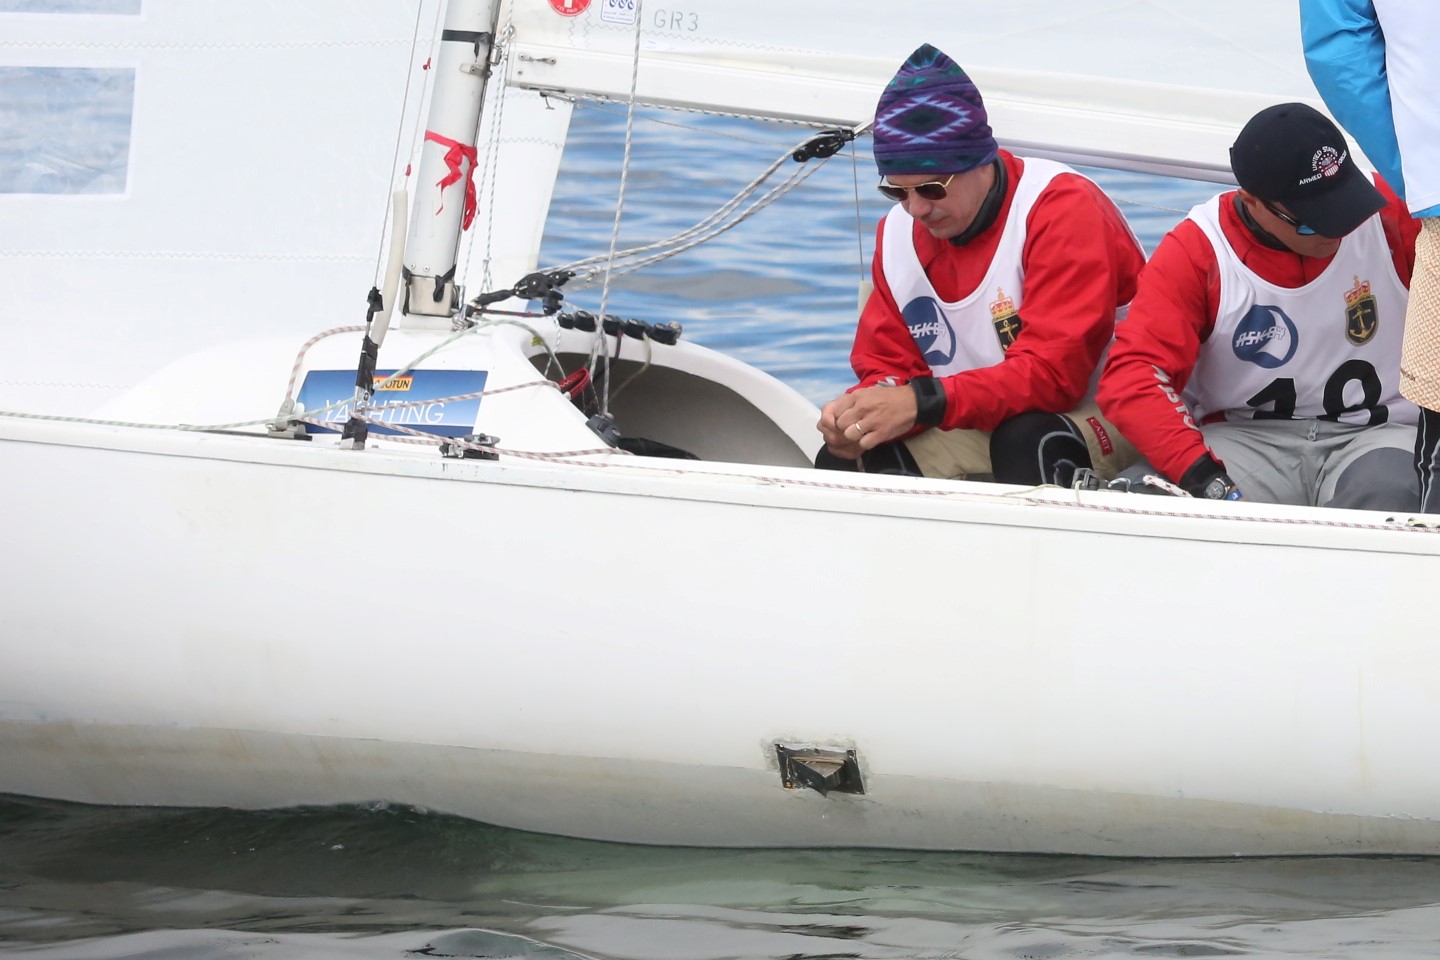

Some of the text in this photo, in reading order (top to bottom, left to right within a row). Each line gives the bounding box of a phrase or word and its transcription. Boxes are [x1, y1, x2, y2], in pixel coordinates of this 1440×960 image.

[654, 9, 699, 32] GR3
[1312, 150, 1322, 171] UNITED
[1299, 173, 1322, 185] ARMED
